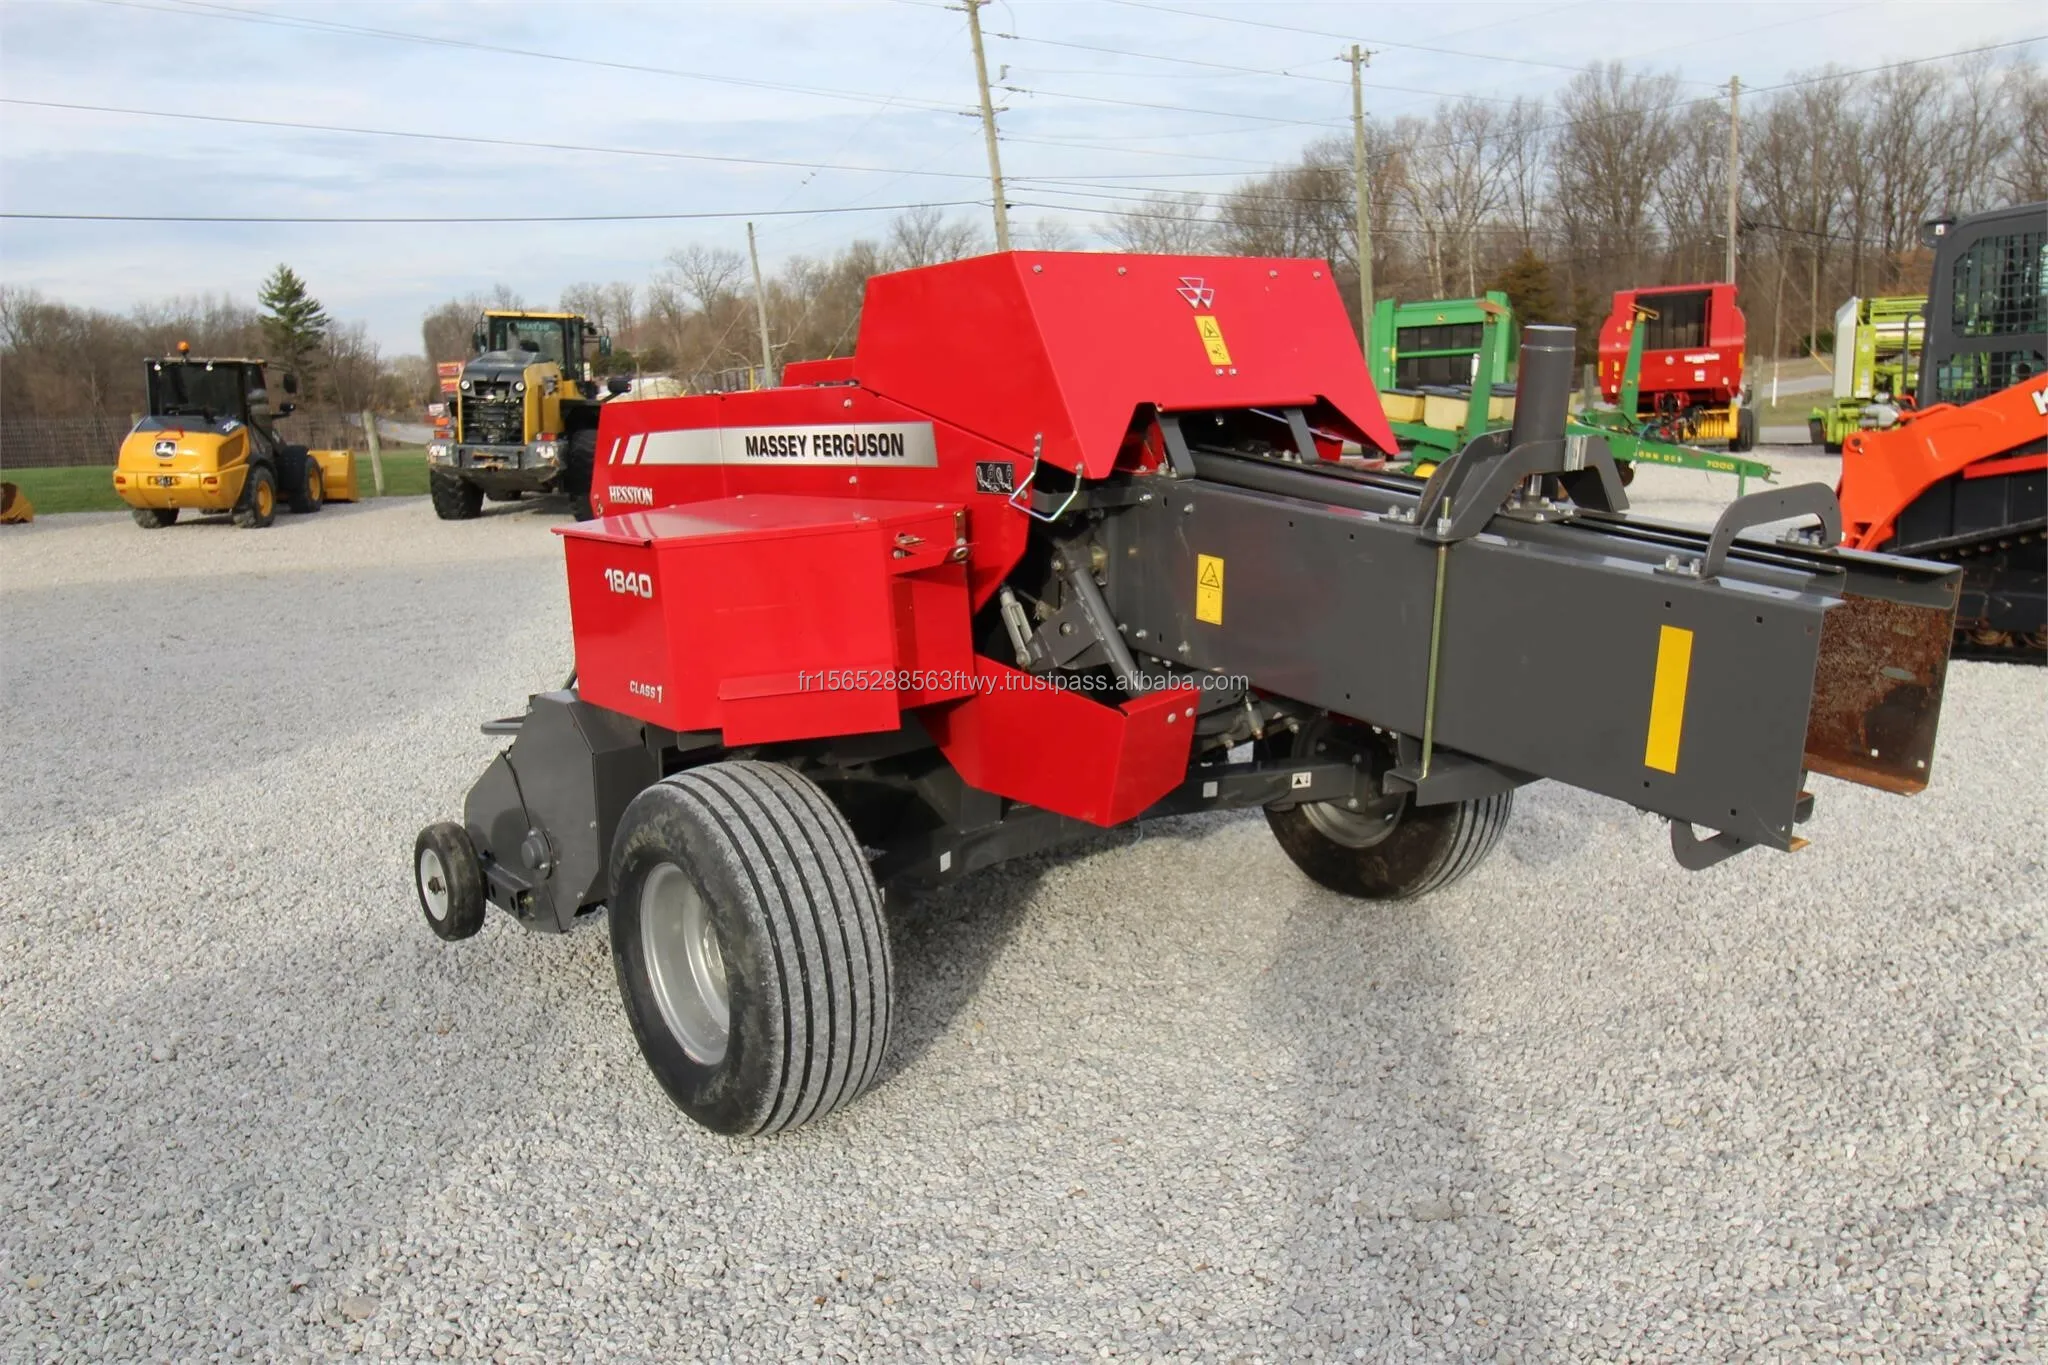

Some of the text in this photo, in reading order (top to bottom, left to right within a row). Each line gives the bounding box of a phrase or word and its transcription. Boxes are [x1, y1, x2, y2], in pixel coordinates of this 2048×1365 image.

[745, 432, 904, 457] MASSEY FERGUSON
[609, 485, 653, 506] HESSTON
[605, 568, 653, 599] 1840
[629, 680, 663, 704] CLASS 1
